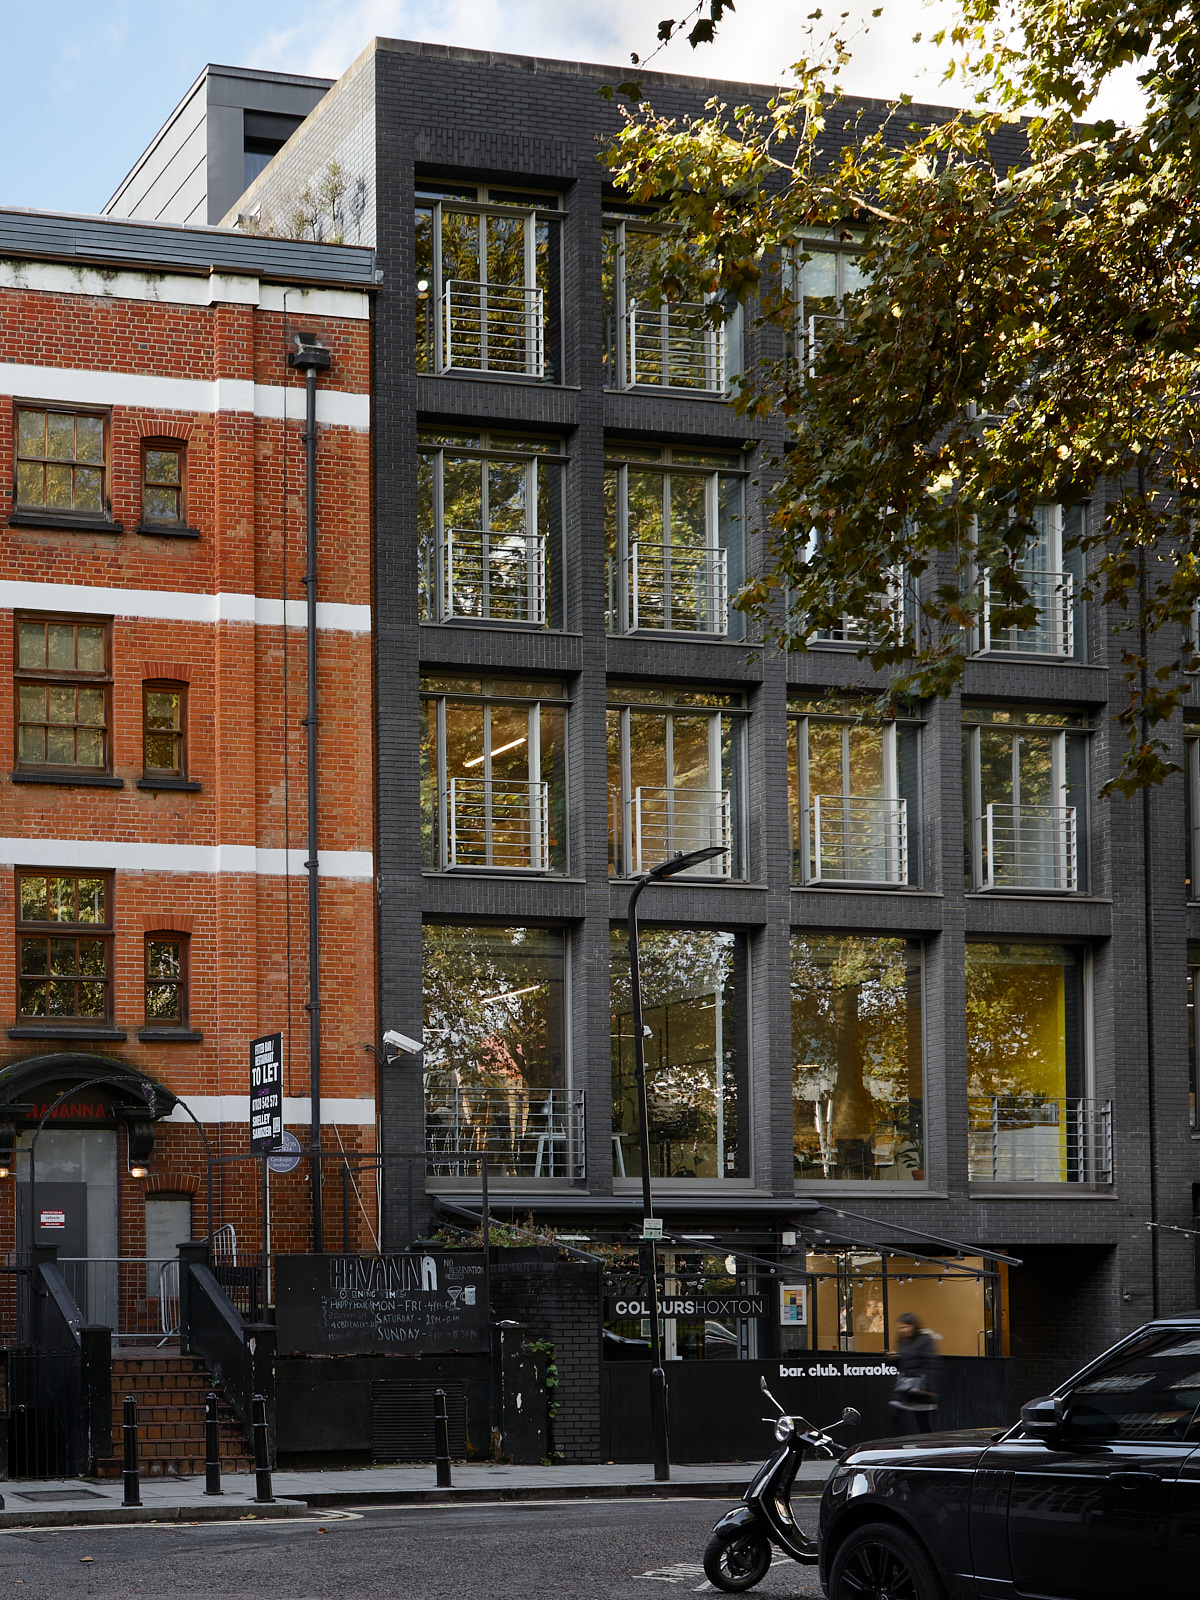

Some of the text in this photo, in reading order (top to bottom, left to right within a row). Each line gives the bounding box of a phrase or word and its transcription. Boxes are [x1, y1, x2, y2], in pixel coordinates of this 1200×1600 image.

[252, 1062, 279, 1087] TO LET
[252, 1113, 270, 1127] SHELLEY
[443, 1259, 454, 1267] NO
[329, 1256, 438, 1291] HAVANNA
[448, 1266, 484, 1275] RESERVATION
[340, 1290, 376, 1299] OENING
[330, 1301, 353, 1311] HAPPY
[373, 1301, 396, 1311] MON
[376, 1312, 415, 1324] SATURDAY
[377, 1327, 420, 1342] SUNDAY
[779, 1362, 900, 1377] bar. club. karaoke.
